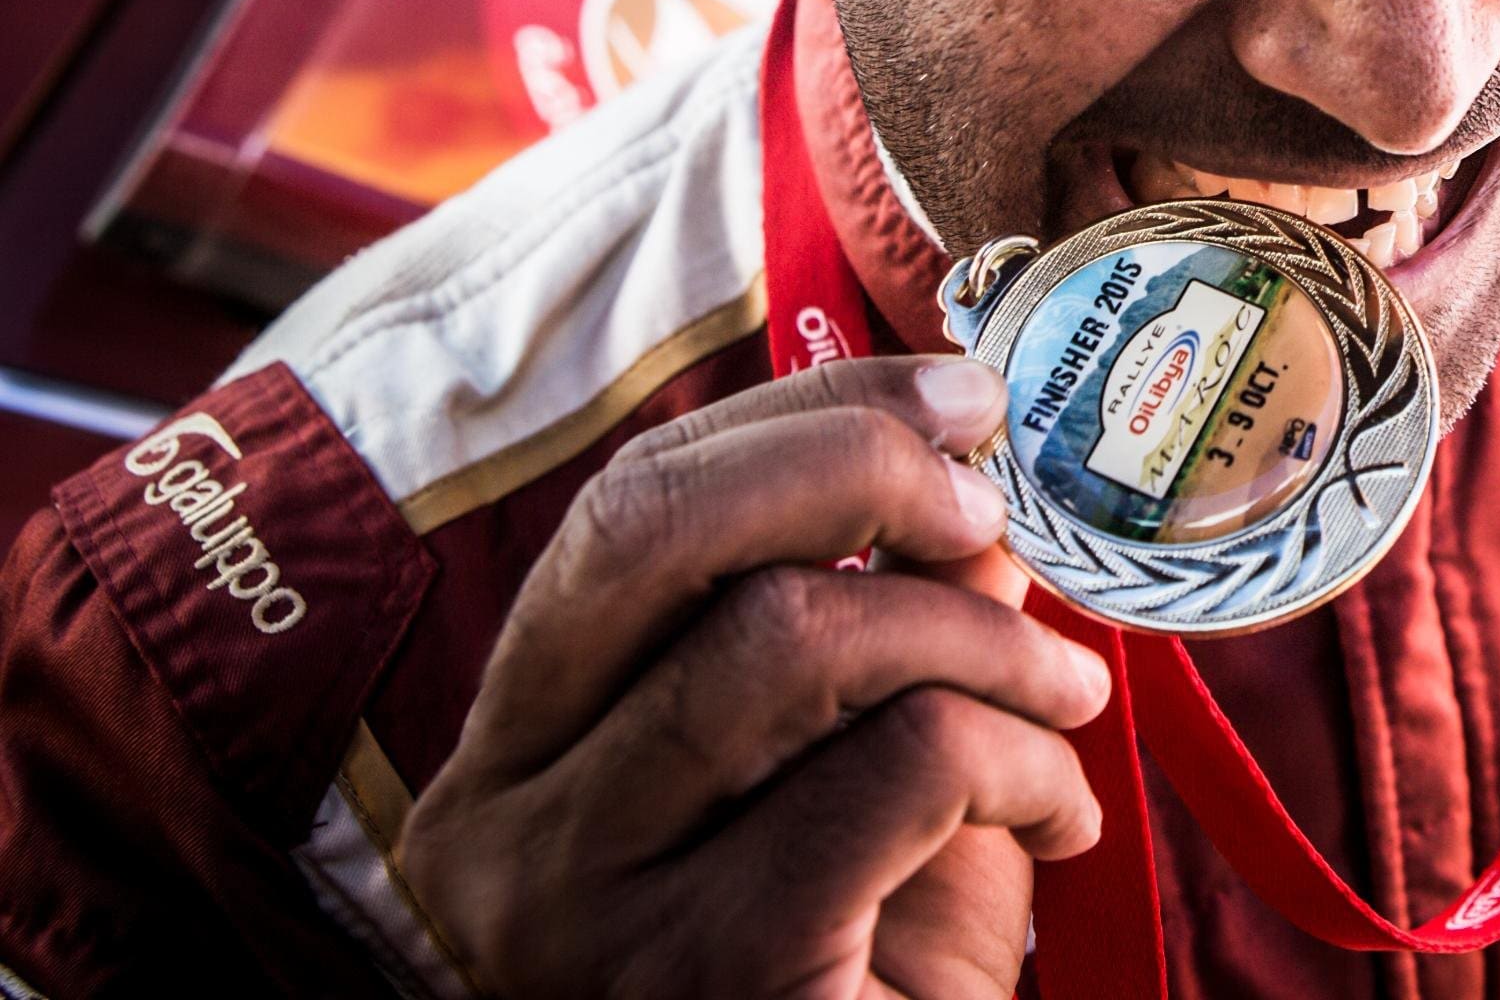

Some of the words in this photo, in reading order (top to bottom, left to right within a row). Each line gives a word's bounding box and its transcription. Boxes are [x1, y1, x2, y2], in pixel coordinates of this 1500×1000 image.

[1021, 316, 1110, 433] FINISHER
[1094, 257, 1142, 315] 2015
[1107, 323, 1166, 415] RALLYE
[1129, 349, 1190, 436] OiLibya
[1207, 447, 1235, 468] 3
[1227, 411, 1254, 431] 9
